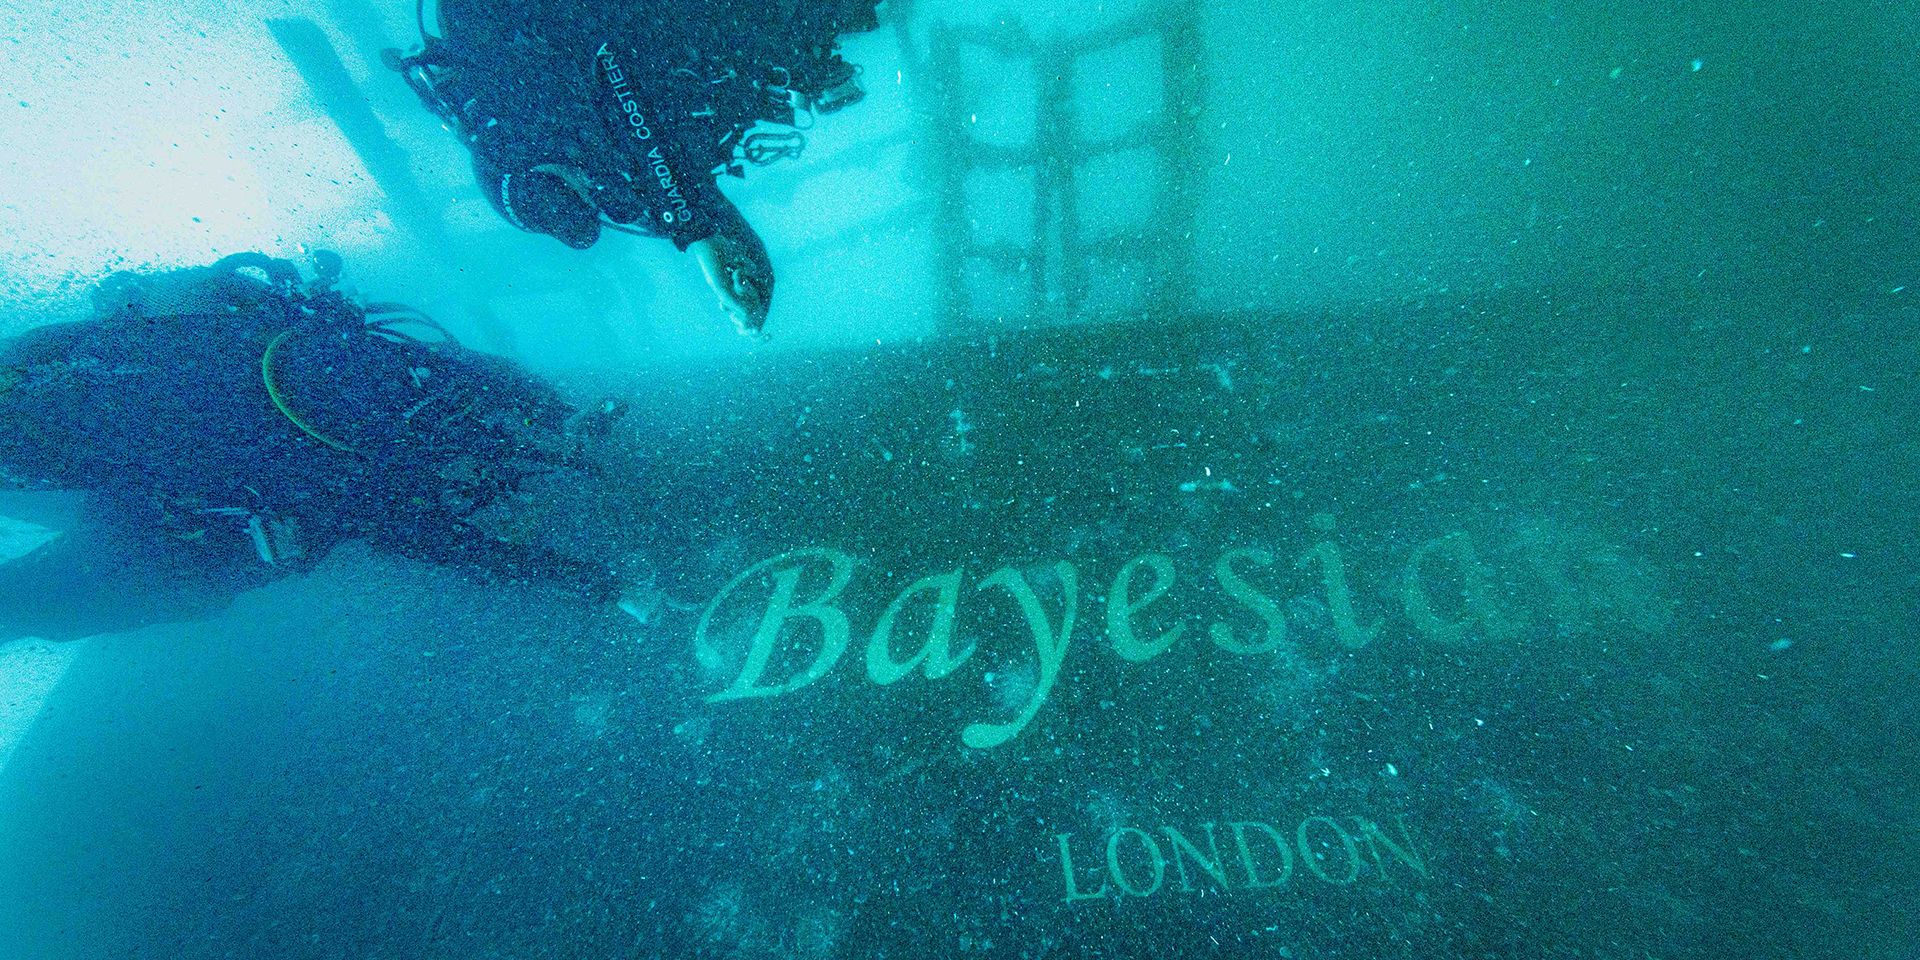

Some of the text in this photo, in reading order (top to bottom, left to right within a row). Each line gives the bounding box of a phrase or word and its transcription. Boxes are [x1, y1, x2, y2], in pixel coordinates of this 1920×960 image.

[597, 43, 691, 221] GUARDIA COSTIERA
[1056, 814, 1431, 903] LONDON
